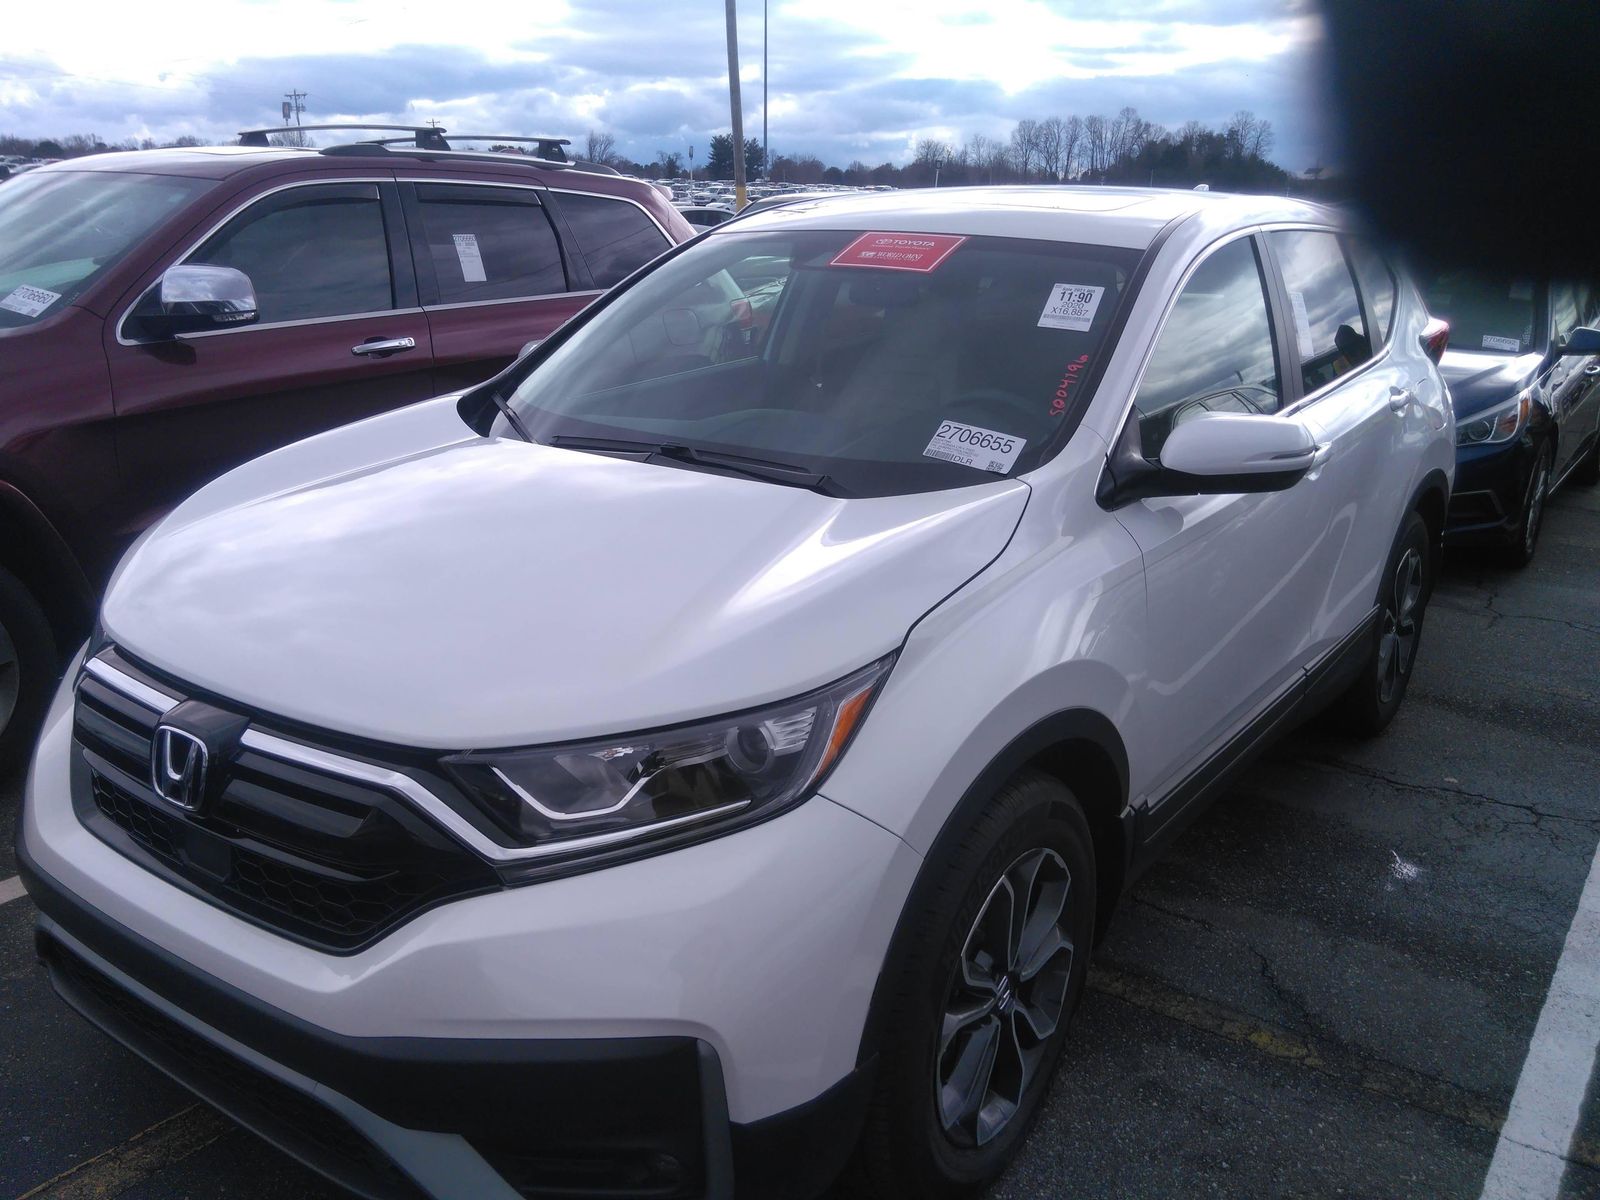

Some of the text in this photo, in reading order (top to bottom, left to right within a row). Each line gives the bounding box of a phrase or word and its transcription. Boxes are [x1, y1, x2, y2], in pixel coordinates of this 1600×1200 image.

[893, 239, 935, 247] TOYOTA
[12, 286, 54, 304] 2706660
[1060, 291, 1092, 303] 11:90
[936, 424, 1015, 454] 2706655
[953, 455, 974, 466] DLR
